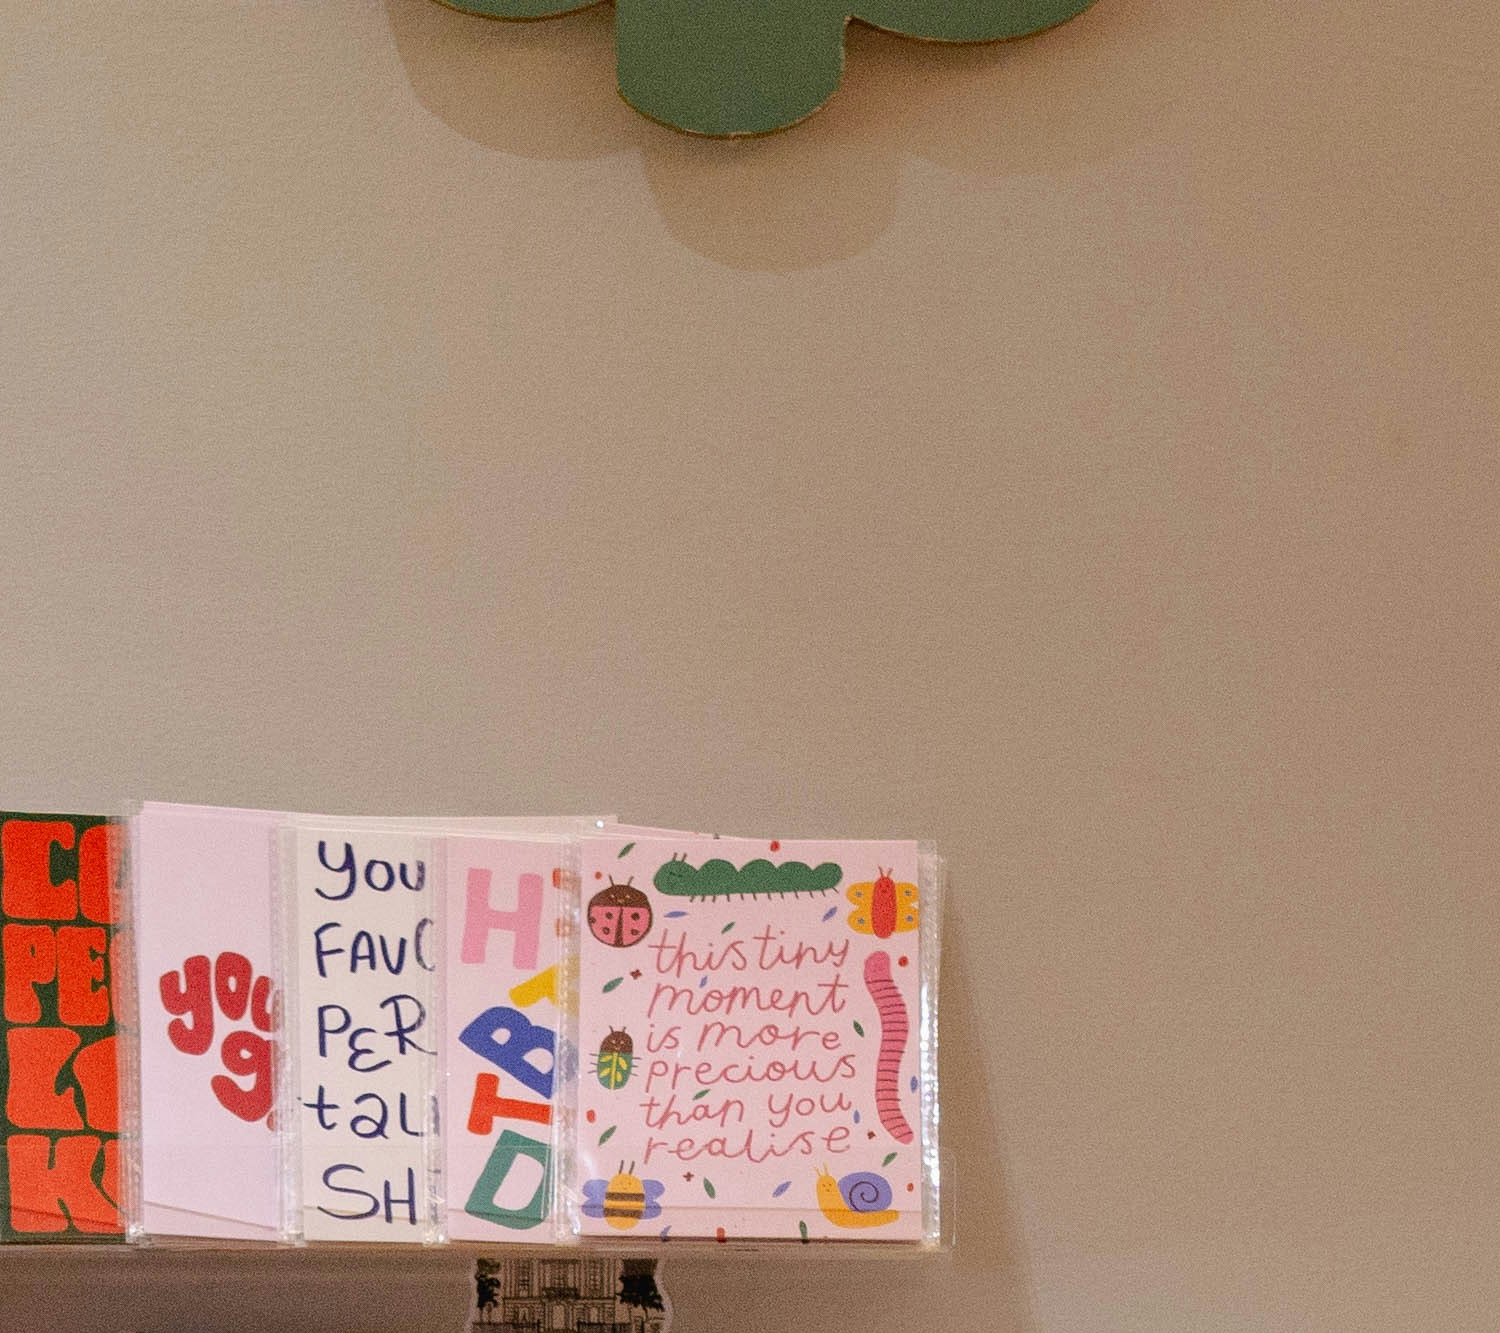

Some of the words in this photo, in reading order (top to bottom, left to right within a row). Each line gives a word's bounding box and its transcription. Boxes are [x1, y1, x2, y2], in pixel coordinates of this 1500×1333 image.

[647, 926, 745, 978] this
[758, 932, 852, 986] tiny
[645, 972, 849, 1022] moment
[644, 1017, 692, 1056] is
[697, 1020, 842, 1058] more
[643, 1050, 860, 1103] precious
[638, 1092, 746, 1132] than
[766, 1090, 856, 1136] you
[641, 1125, 854, 1168] realise
